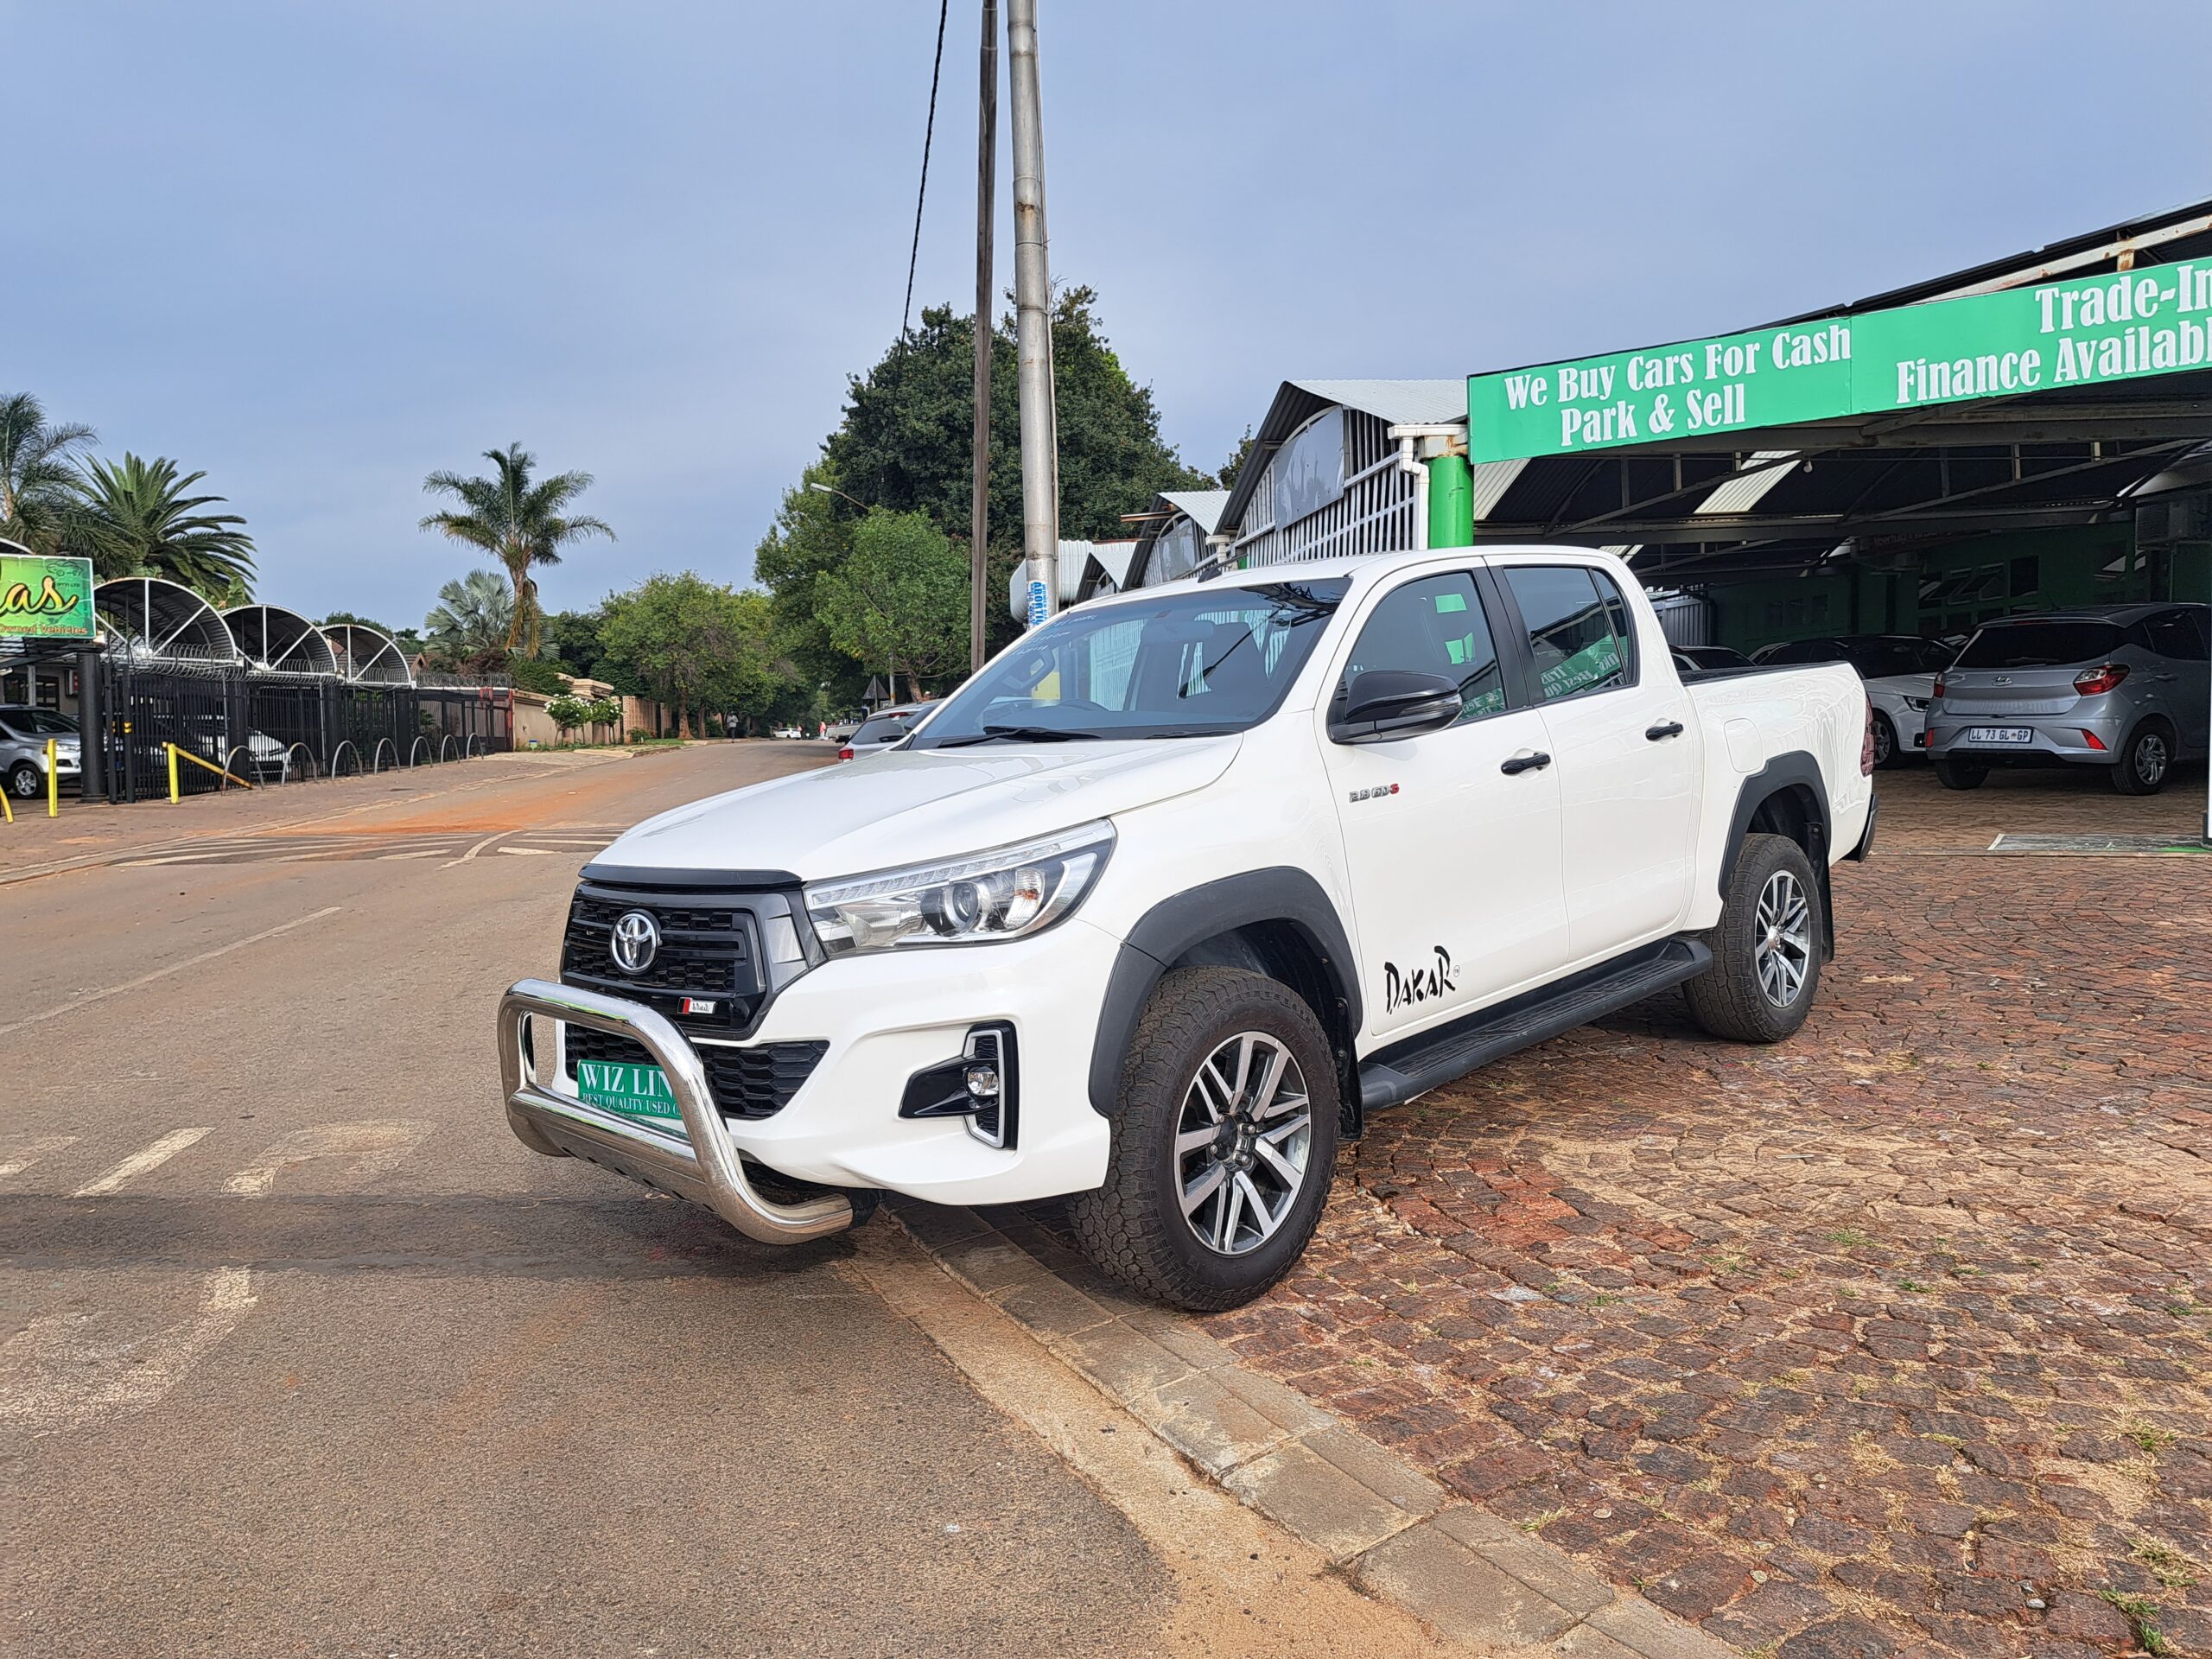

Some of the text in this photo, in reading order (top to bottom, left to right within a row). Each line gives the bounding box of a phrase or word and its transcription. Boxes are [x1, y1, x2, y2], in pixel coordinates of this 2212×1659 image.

[2035, 264, 2212, 334] Trade-In
[1503, 323, 1852, 410] We Buy Cars For Cash
[1896, 348, 2041, 404] Finance
[1560, 383, 1745, 448] Park & Sell
[0, 575, 79, 616] as
[1033, 582, 1044, 626] ABORTIO
[41, 624, 88, 635] Vehicles
[1971, 729, 1981, 740] LL
[1986, 729, 1996, 740] 73
[2017, 730, 2029, 741] GP
[1384, 945, 1456, 1014] DAKAR
[581, 1063, 673, 1099] WIZ LIN
[606, 1095, 644, 1111] QUALITY
[646, 1099, 671, 1115] USED
